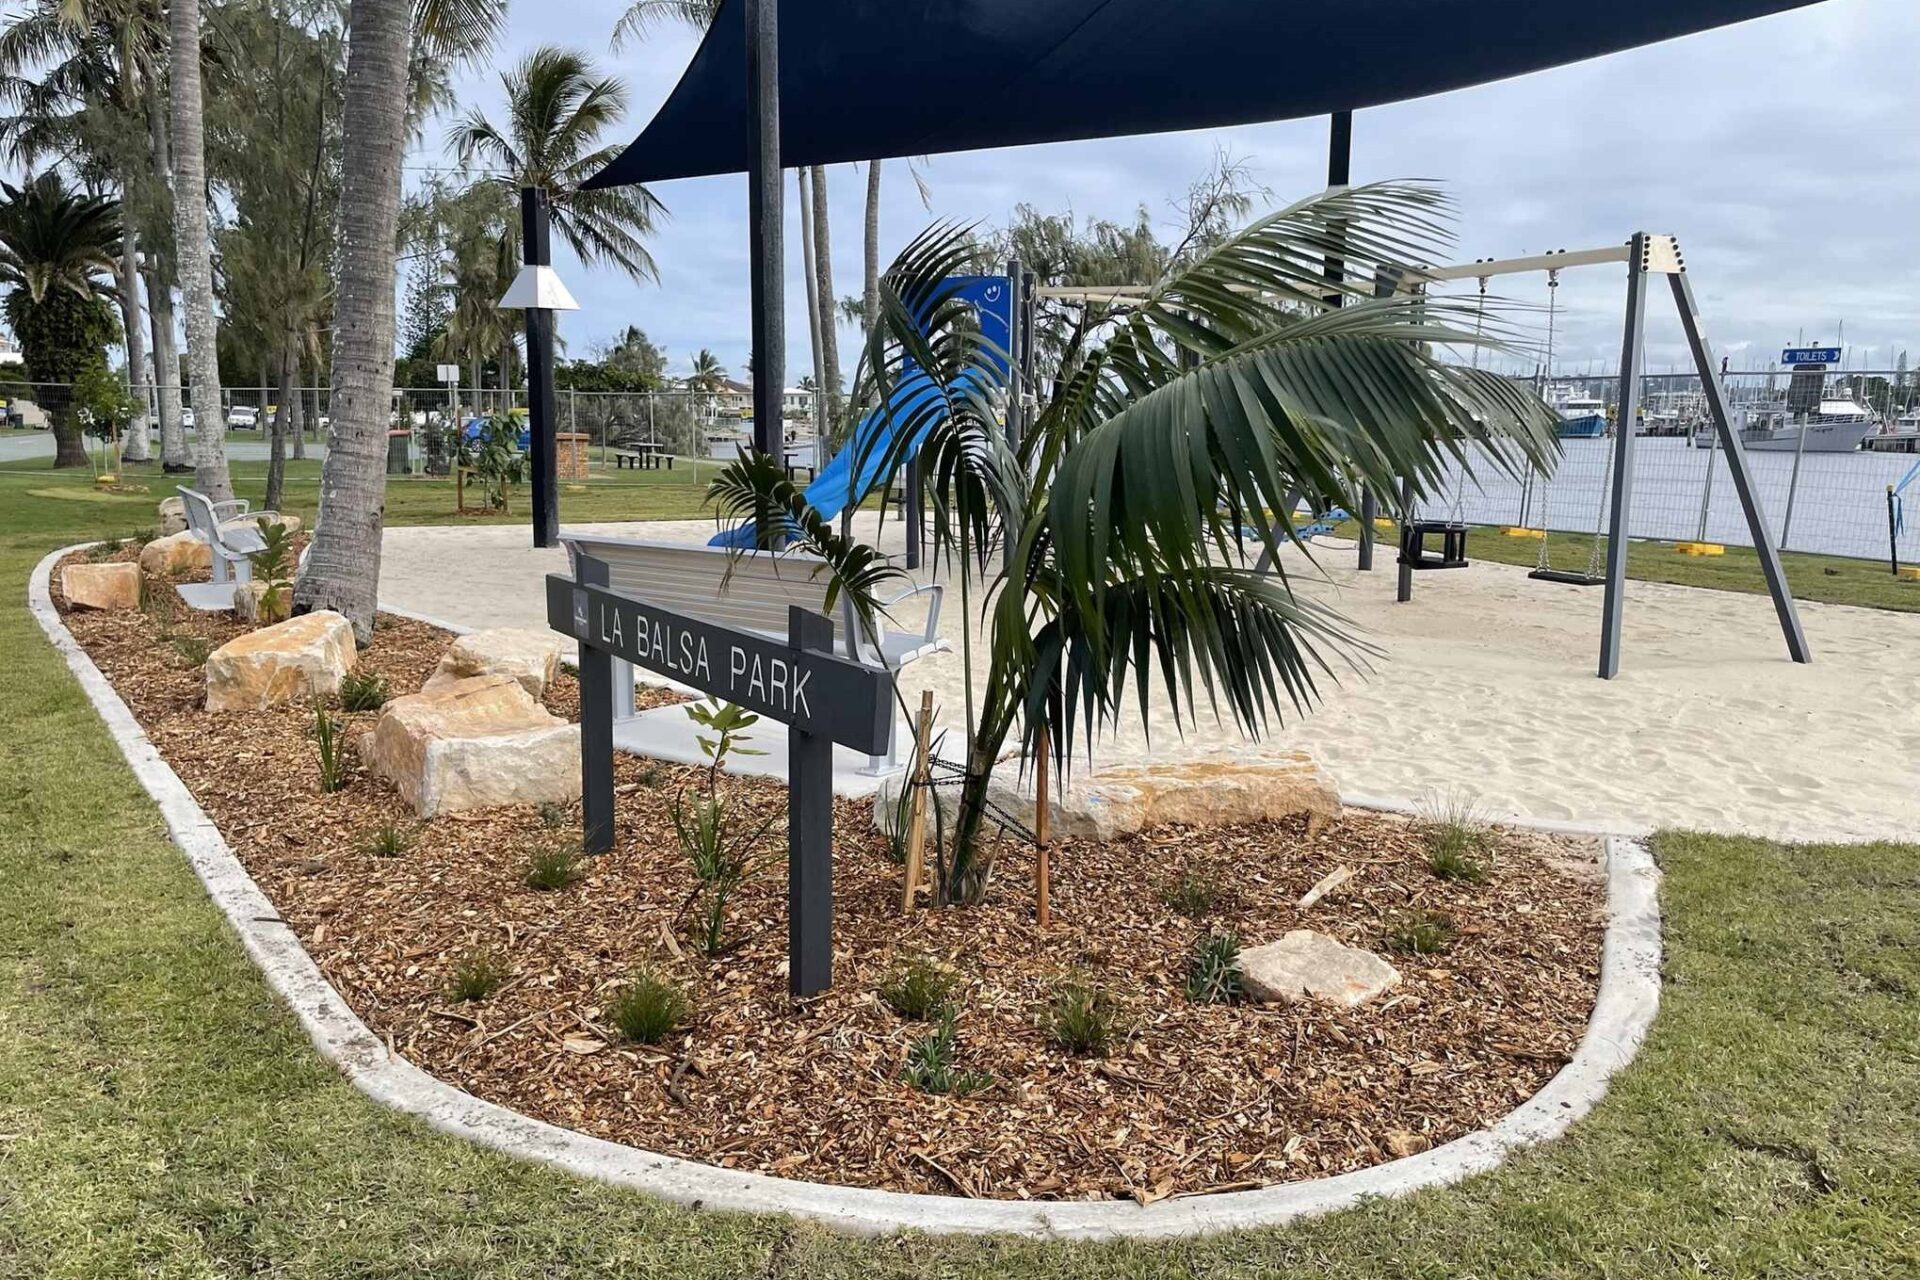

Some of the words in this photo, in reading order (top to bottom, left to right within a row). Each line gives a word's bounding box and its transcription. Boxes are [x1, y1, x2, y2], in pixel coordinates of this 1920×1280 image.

[1796, 351, 1827, 361] TOILETS
[601, 603, 624, 648] LA
[638, 615, 711, 682] BALSA
[731, 646, 811, 719] PARK
